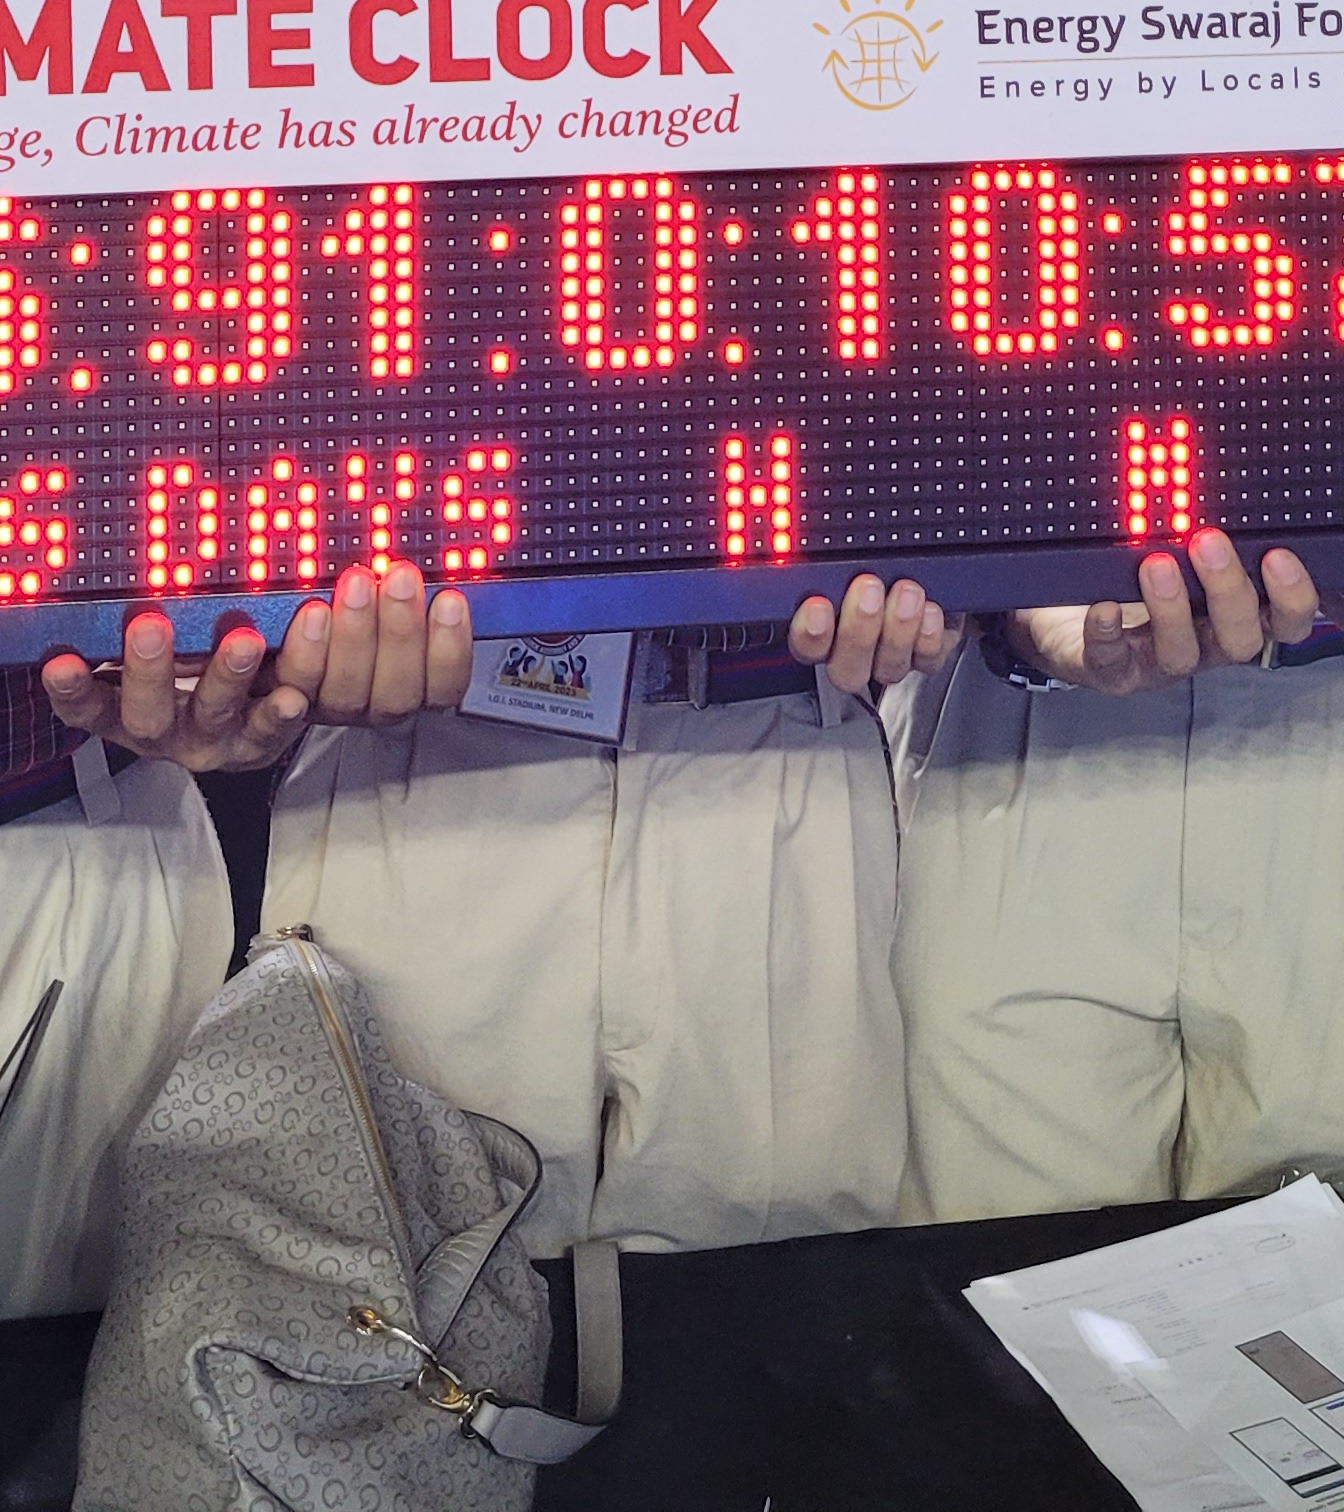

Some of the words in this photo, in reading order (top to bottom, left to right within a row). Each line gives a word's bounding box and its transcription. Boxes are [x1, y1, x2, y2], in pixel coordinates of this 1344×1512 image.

[975, 9, 1126, 54] Energy
[1141, 0, 1281, 48] Swaraj
[980, 76, 1113, 102] Energy
[1138, 71, 1176, 99] by
[1201, 67, 1321, 91] Locals
[75, 113, 262, 157] Climate
[277, 107, 357, 149] has
[372, 100, 543, 154] already
[557, 93, 740, 148] changed
[146, 447, 513, 590] DAYS
[548, 705, 569, 716] NEW
[570, 708, 594, 720] DELHI
